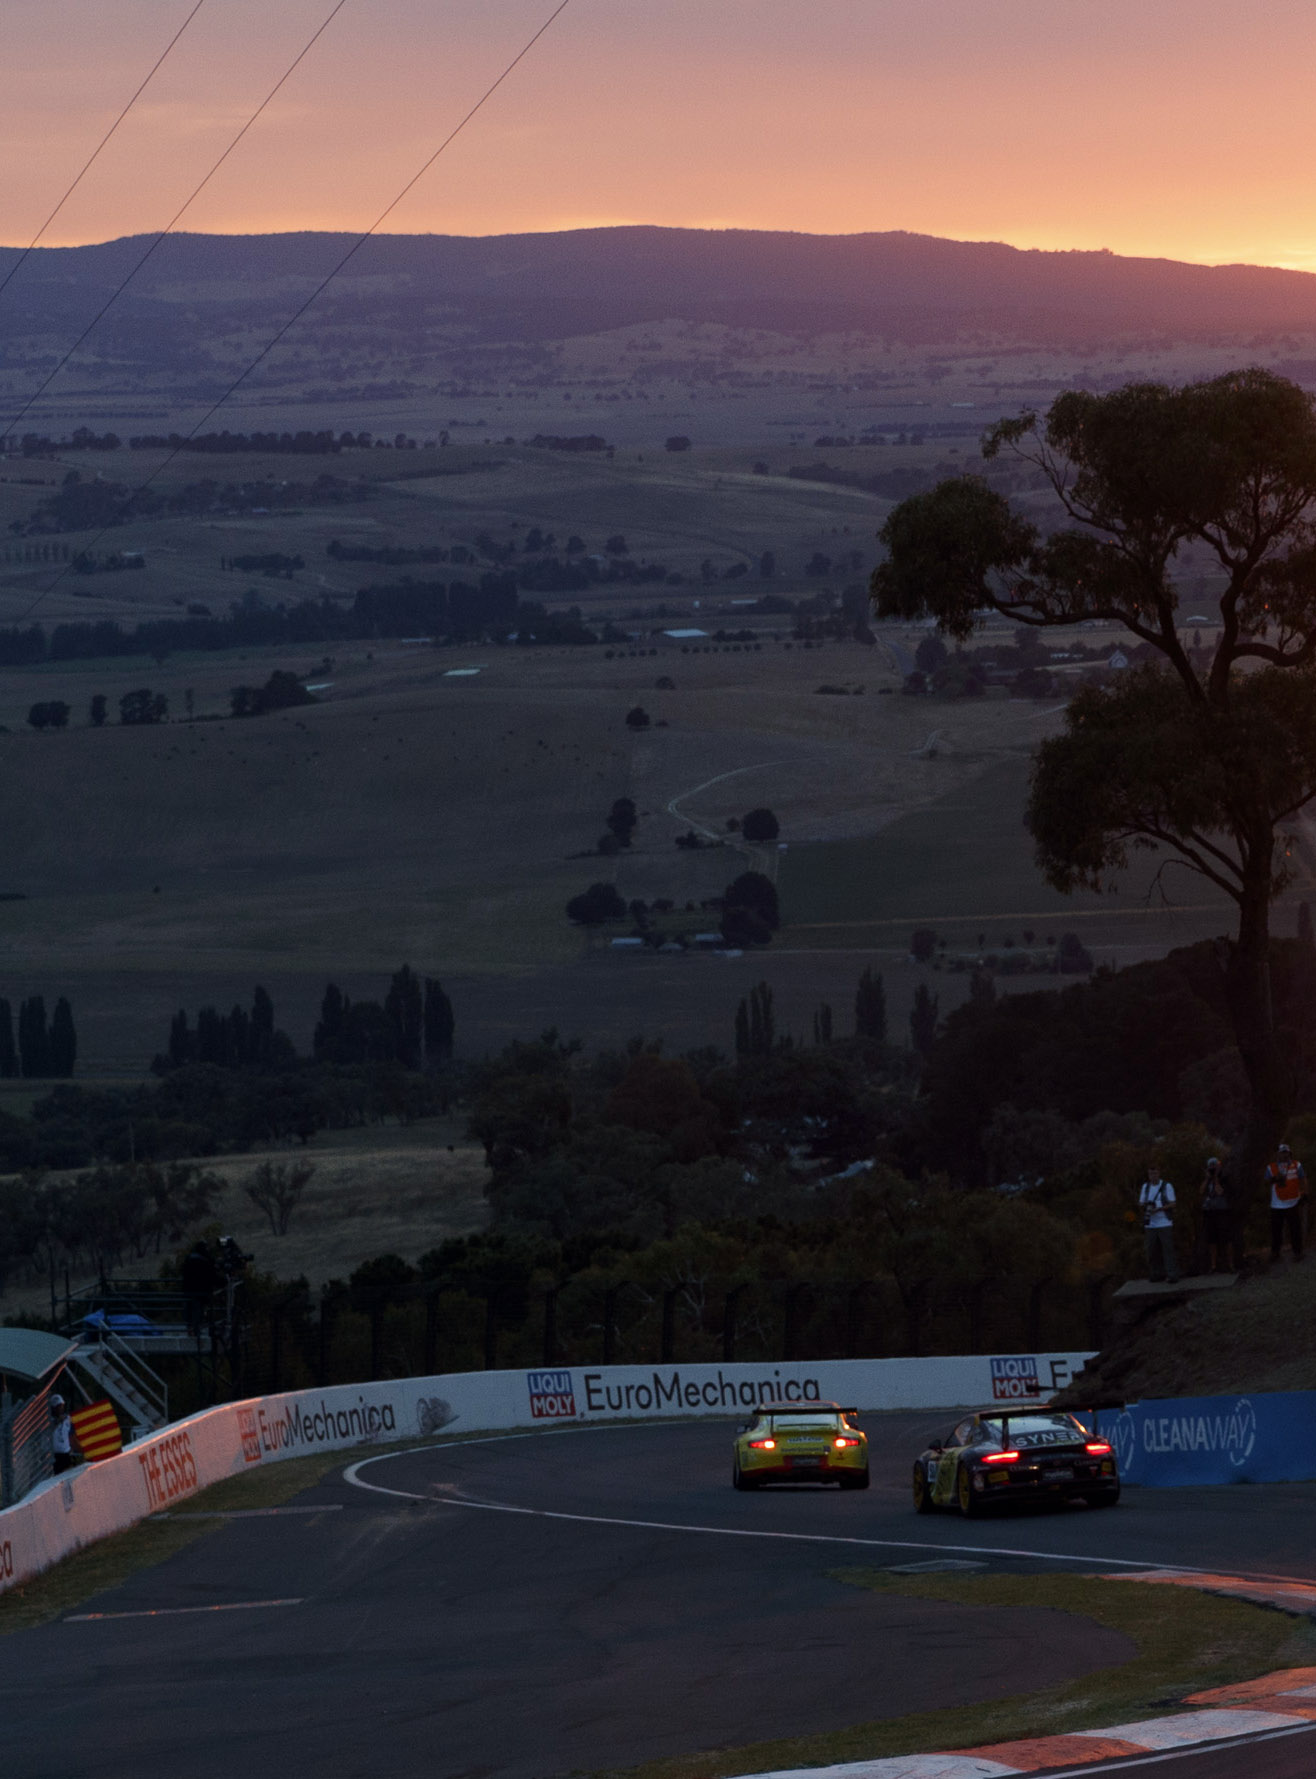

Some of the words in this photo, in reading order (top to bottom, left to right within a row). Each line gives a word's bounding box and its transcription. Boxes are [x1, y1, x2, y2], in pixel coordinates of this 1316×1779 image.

[529, 1372, 571, 1394] LIQUI
[993, 1360, 1036, 1377] LIQUI
[584, 1370, 820, 1411] EuroMechanica
[995, 1379, 1038, 1397] MOLY
[532, 1395, 575, 1417] MOLY
[258, 1396, 396, 1452] EuroMechanica
[1143, 1413, 1249, 1452] CLEANAWAY
[139, 1448, 166, 1510] THE
[159, 1431, 197, 1498] ESSES
